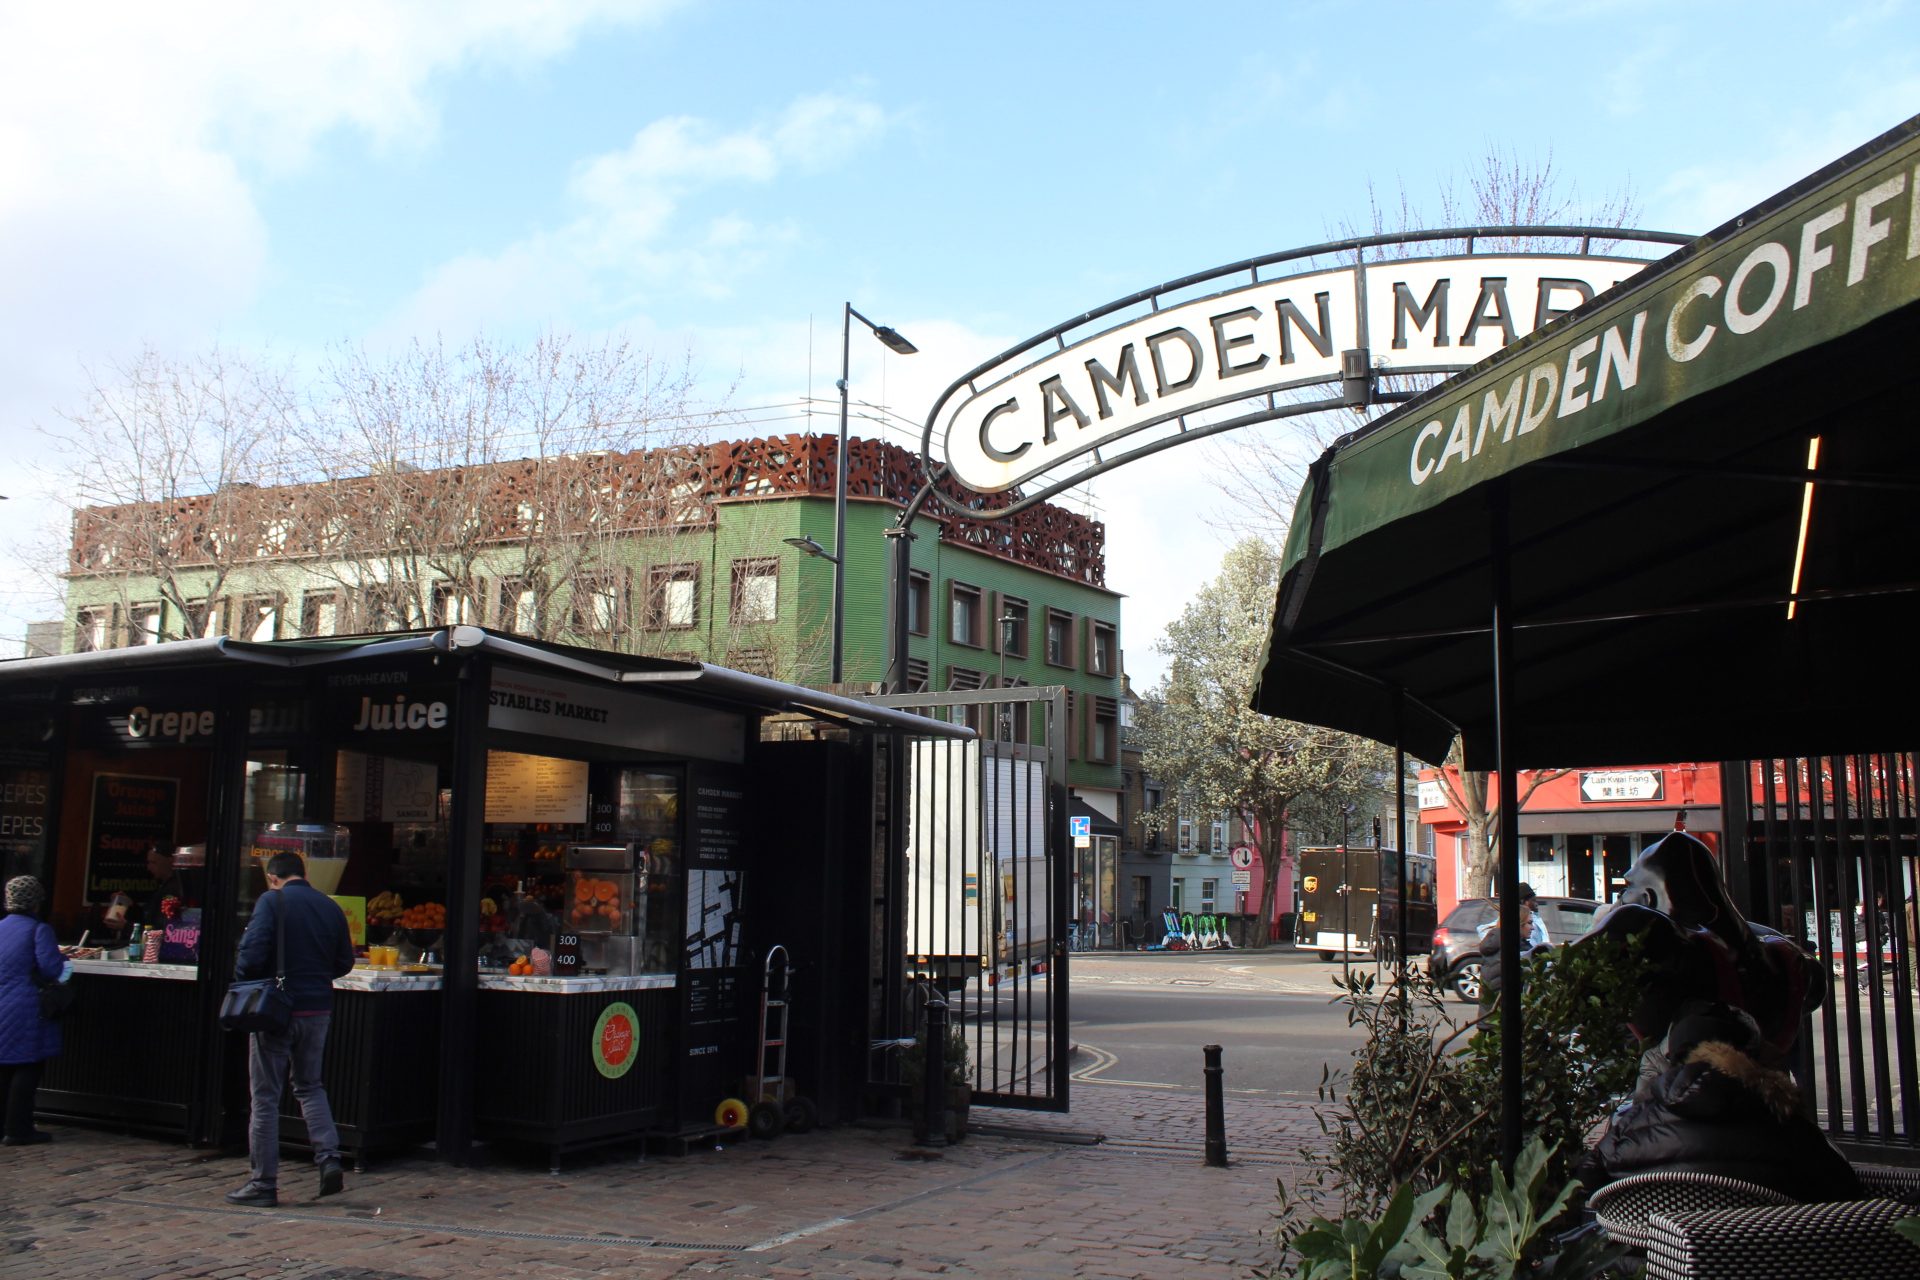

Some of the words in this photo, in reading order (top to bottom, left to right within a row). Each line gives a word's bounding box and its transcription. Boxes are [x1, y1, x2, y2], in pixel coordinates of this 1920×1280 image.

[1409, 310, 1648, 486] CAMDEN
[1665, 165, 1920, 362] COFF
[978, 291, 1333, 463] CAMDEN
[1391, 276, 1625, 350] MAR
[327, 671, 408, 687] SEVEN-HEAVEN
[353, 694, 449, 731] Juice
[488, 690, 551, 714] STABLES
[555, 701, 609, 723] MARKET
[127, 706, 215, 743] Crepe
[1607, 775, 1627, 784] Kwai
[1628, 774, 1649, 784] Fong
[108, 782, 166, 804] Orange
[697, 787, 721, 797] CAMDEN
[721, 790, 743, 799] MARKET
[114, 801, 156, 816] Juice
[396, 810, 429, 818] SANGRIA
[99, 834, 154, 854] Sangri
[90, 874, 158, 891] Lemonad
[558, 935, 577, 946] 3.00
[557, 955, 576, 965] 4.00
[600, 1005, 635, 1025] FRESHLY
[597, 1051, 635, 1076] SQUEEZED
